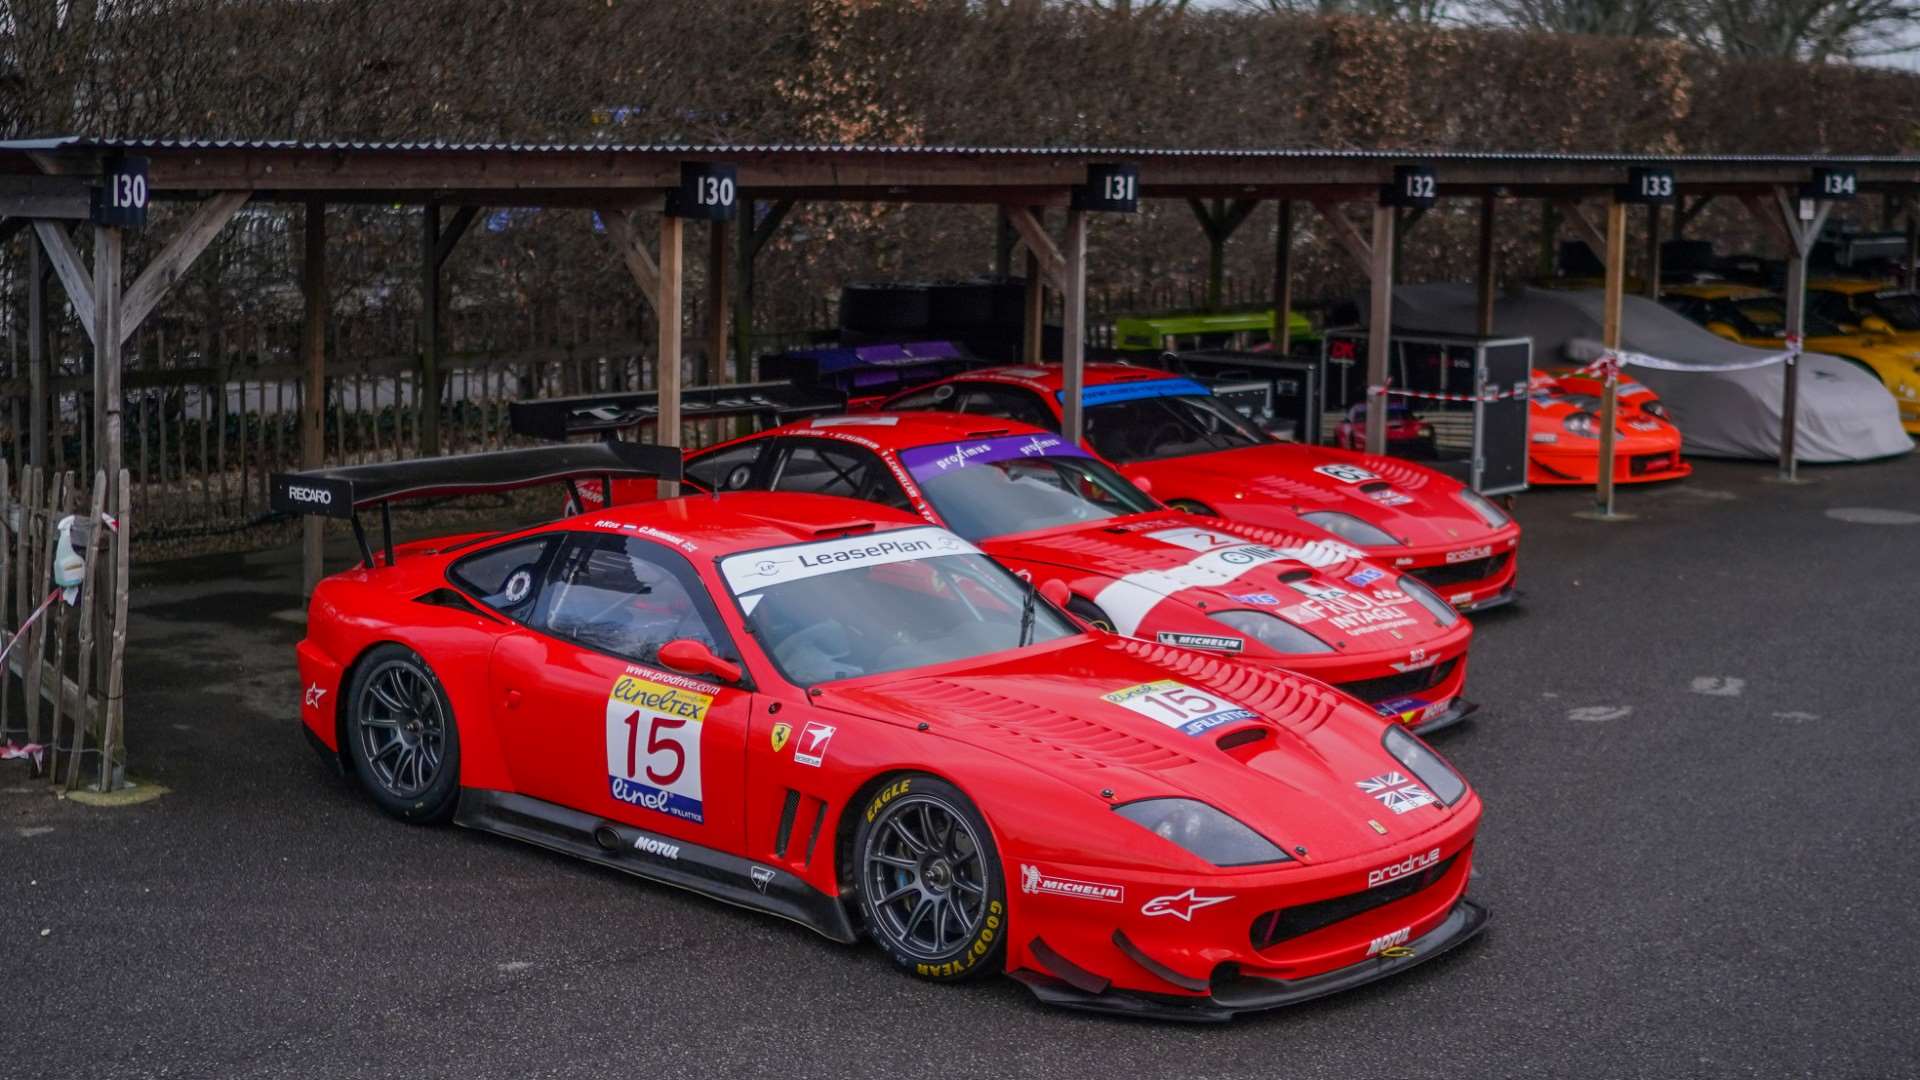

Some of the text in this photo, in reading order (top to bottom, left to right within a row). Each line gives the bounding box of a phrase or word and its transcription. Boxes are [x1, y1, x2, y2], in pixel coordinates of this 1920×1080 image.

[113, 174, 146, 208] 130
[697, 176, 734, 207] 130
[1105, 175, 1134, 200] 131
[1407, 176, 1434, 198] 132
[1641, 176, 1672, 196] 133
[1824, 175, 1855, 194] 134
[288, 485, 332, 505] RECARO
[798, 539, 933, 568] LeasePlan
[1179, 636, 1240, 648] MICHELIN
[625, 664, 721, 696] www.prodrive.com
[1144, 688, 1218, 720] 15
[624, 709, 687, 786] 15
[612, 778, 669, 812] linel
[866, 778, 912, 825] EAGLE
[634, 836, 680, 860] MOTUL
[1043, 879, 1120, 898] MICHELIN
